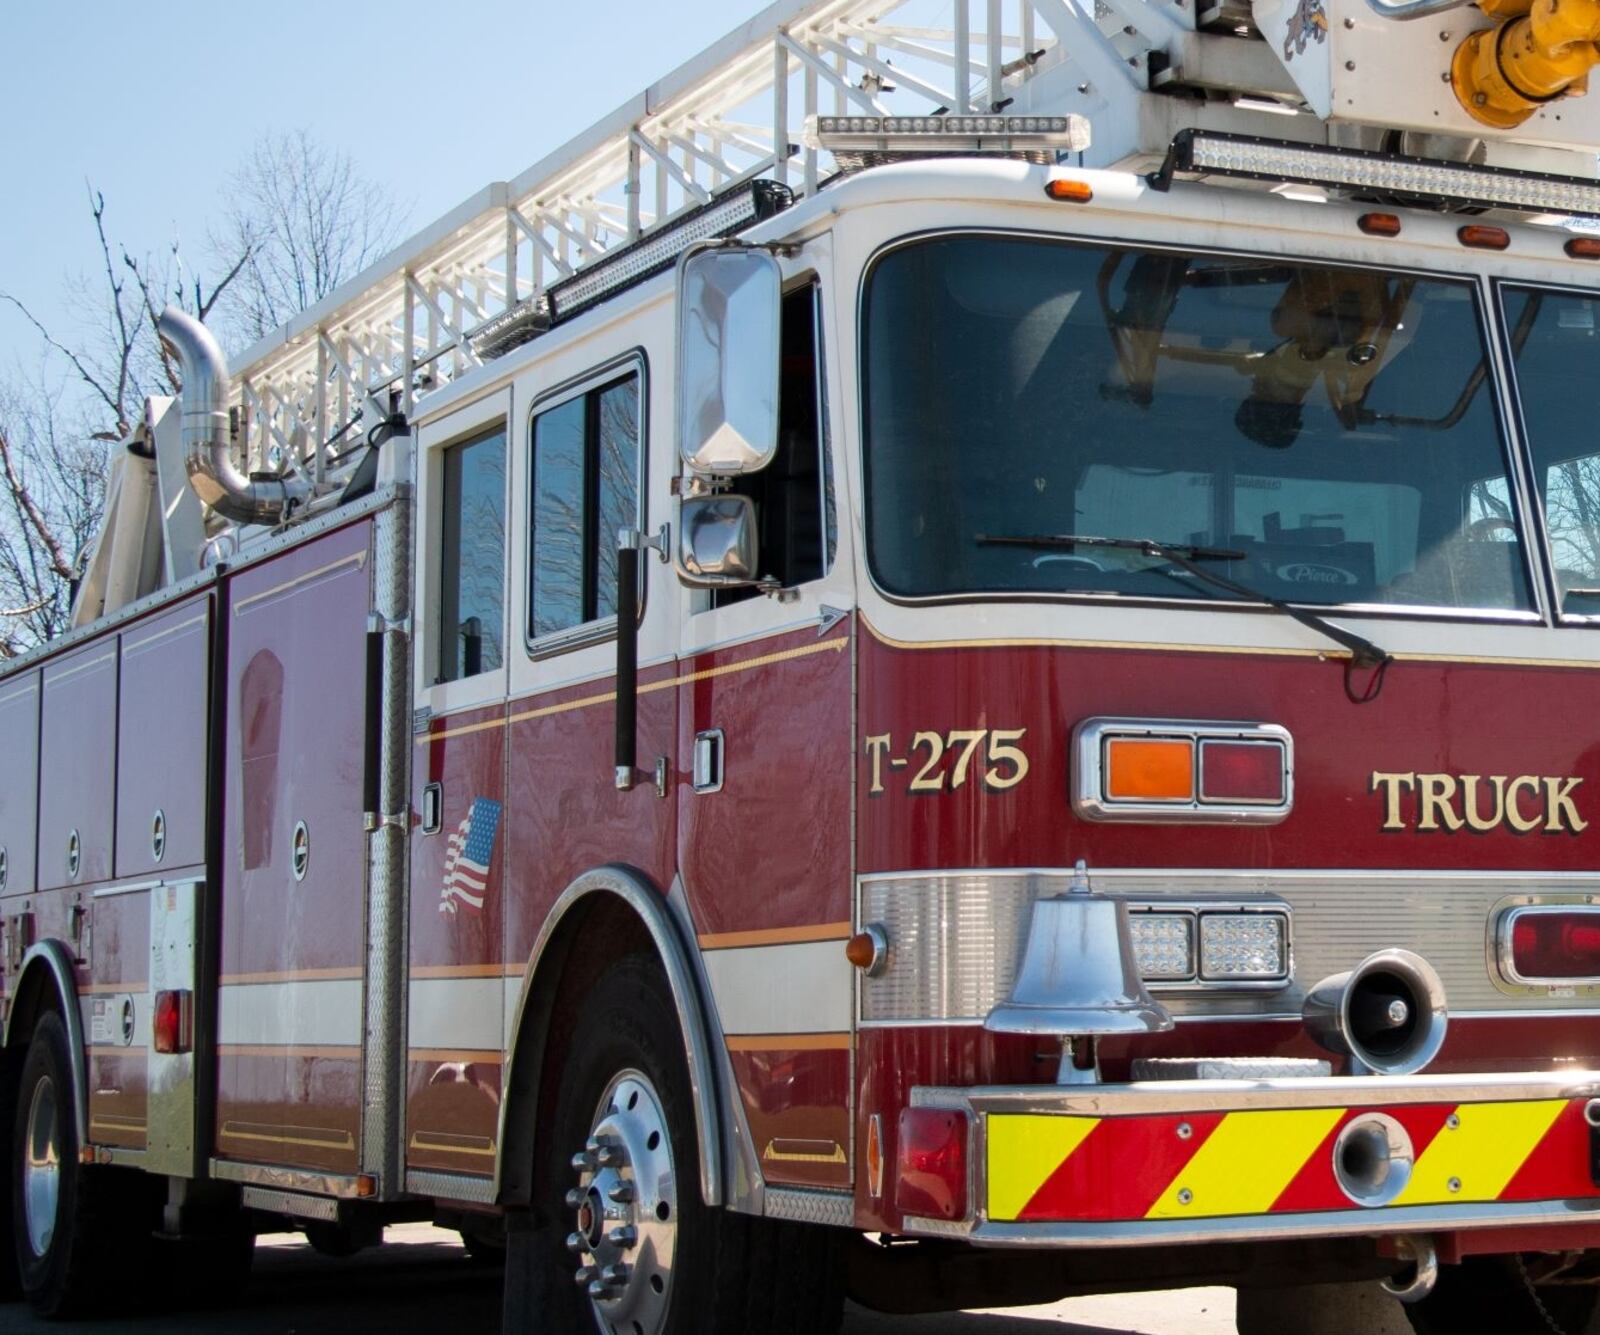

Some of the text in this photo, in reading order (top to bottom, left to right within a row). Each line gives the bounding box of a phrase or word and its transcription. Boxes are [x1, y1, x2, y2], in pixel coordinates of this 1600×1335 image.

[1295, 566, 1339, 583] Pierce
[865, 728, 1029, 793] T-275
[1371, 771, 1589, 832] TRUCK
